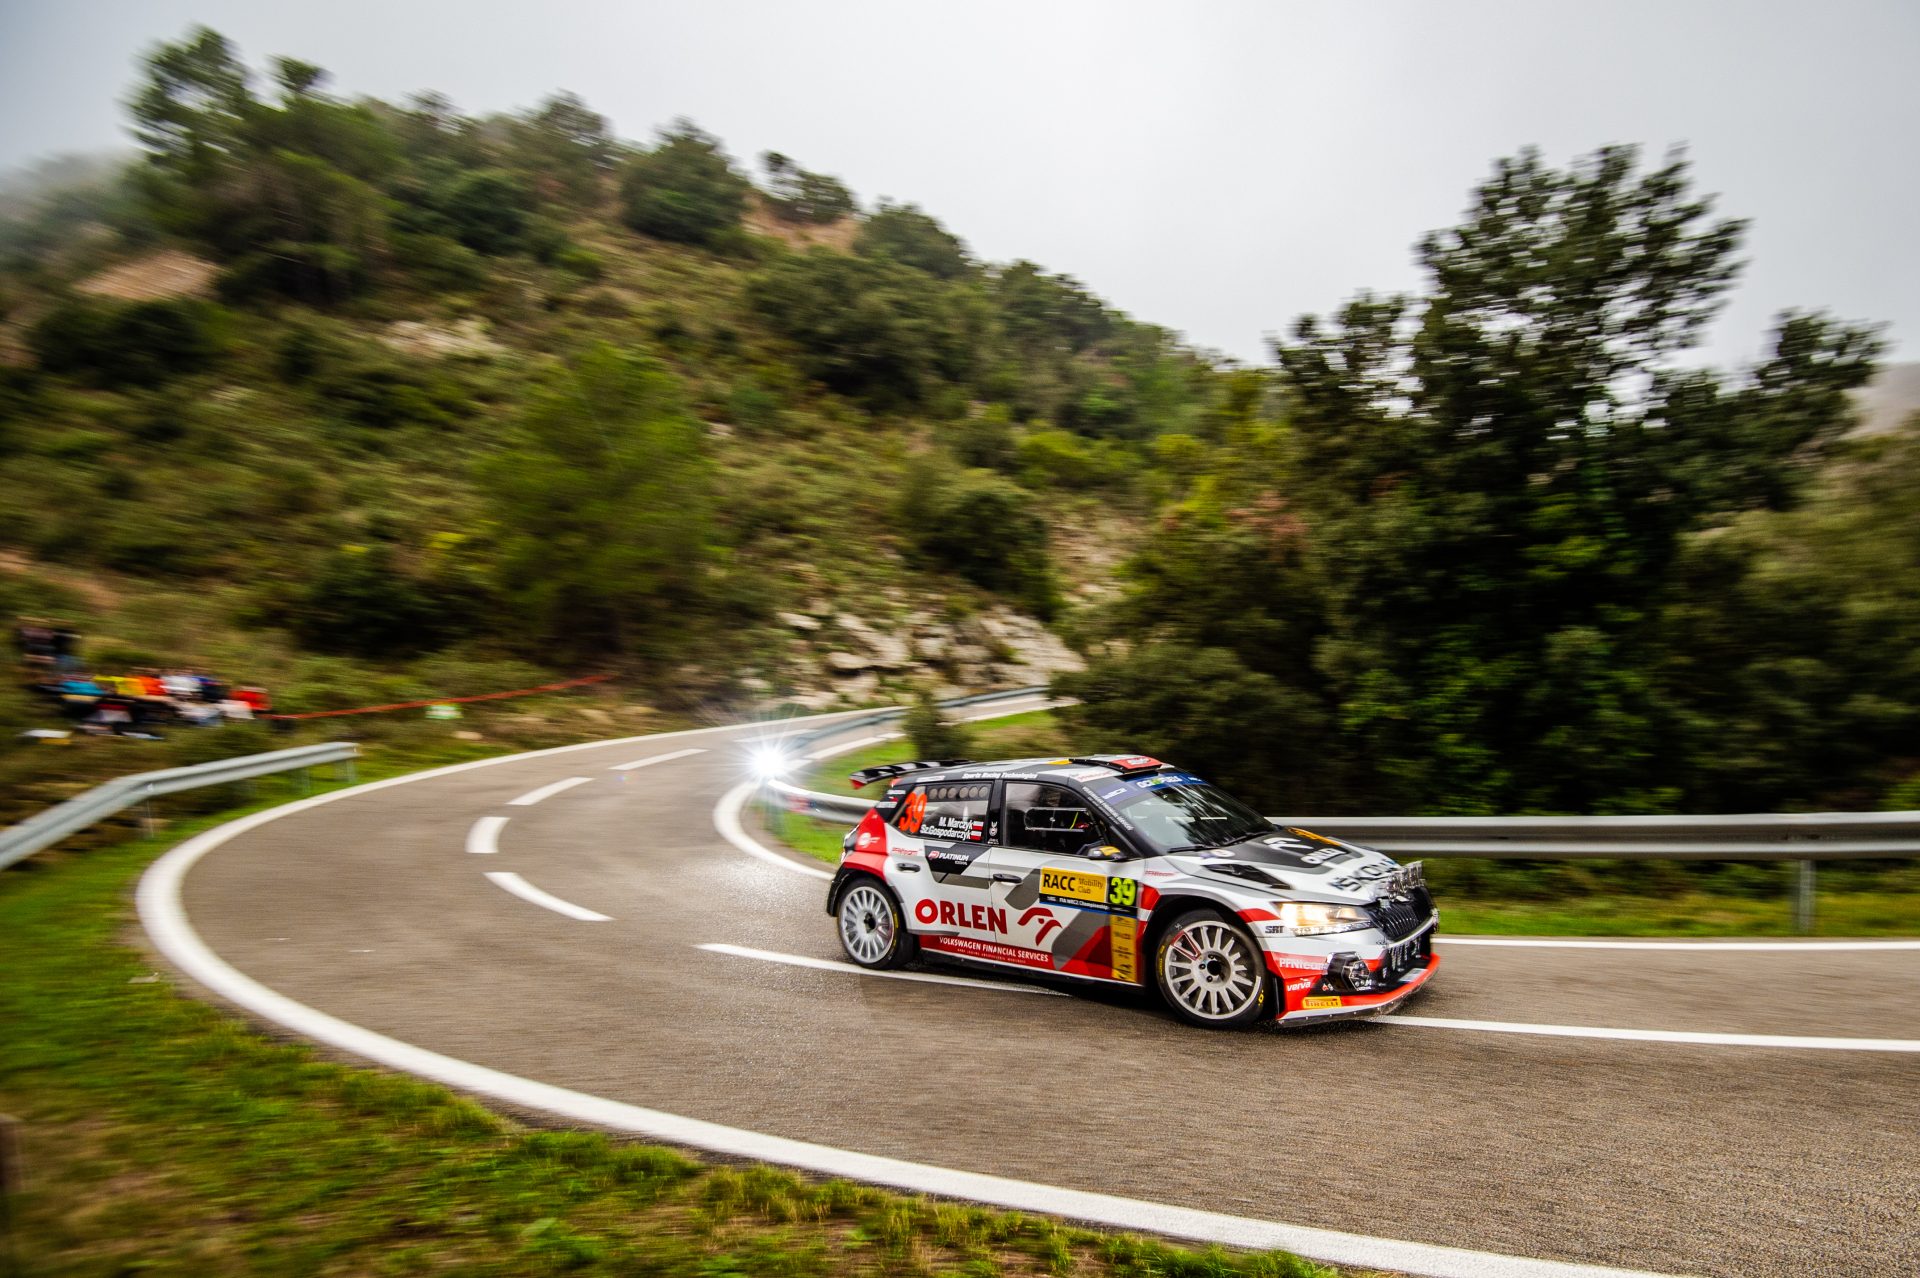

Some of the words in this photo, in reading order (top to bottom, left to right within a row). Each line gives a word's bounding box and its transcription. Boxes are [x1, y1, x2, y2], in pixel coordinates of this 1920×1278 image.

[898, 791, 927, 833] 39
[939, 817, 948, 827] M.
[948, 817, 974, 833] Marczyk
[938, 852, 969, 862] PLATINUM
[1042, 873, 1076, 892] RACC
[1078, 877, 1104, 889] Mobility
[1077, 886, 1092, 895] Club
[1109, 877, 1136, 906] 39
[915, 898, 1008, 935] ORLEN
[1264, 925, 1284, 934] SRT
[939, 936, 982, 951] VOLKSWAGEN
[982, 944, 1017, 957] FINANCIAL
[1017, 949, 1049, 963] SERVICES
[1287, 980, 1311, 992] verva
